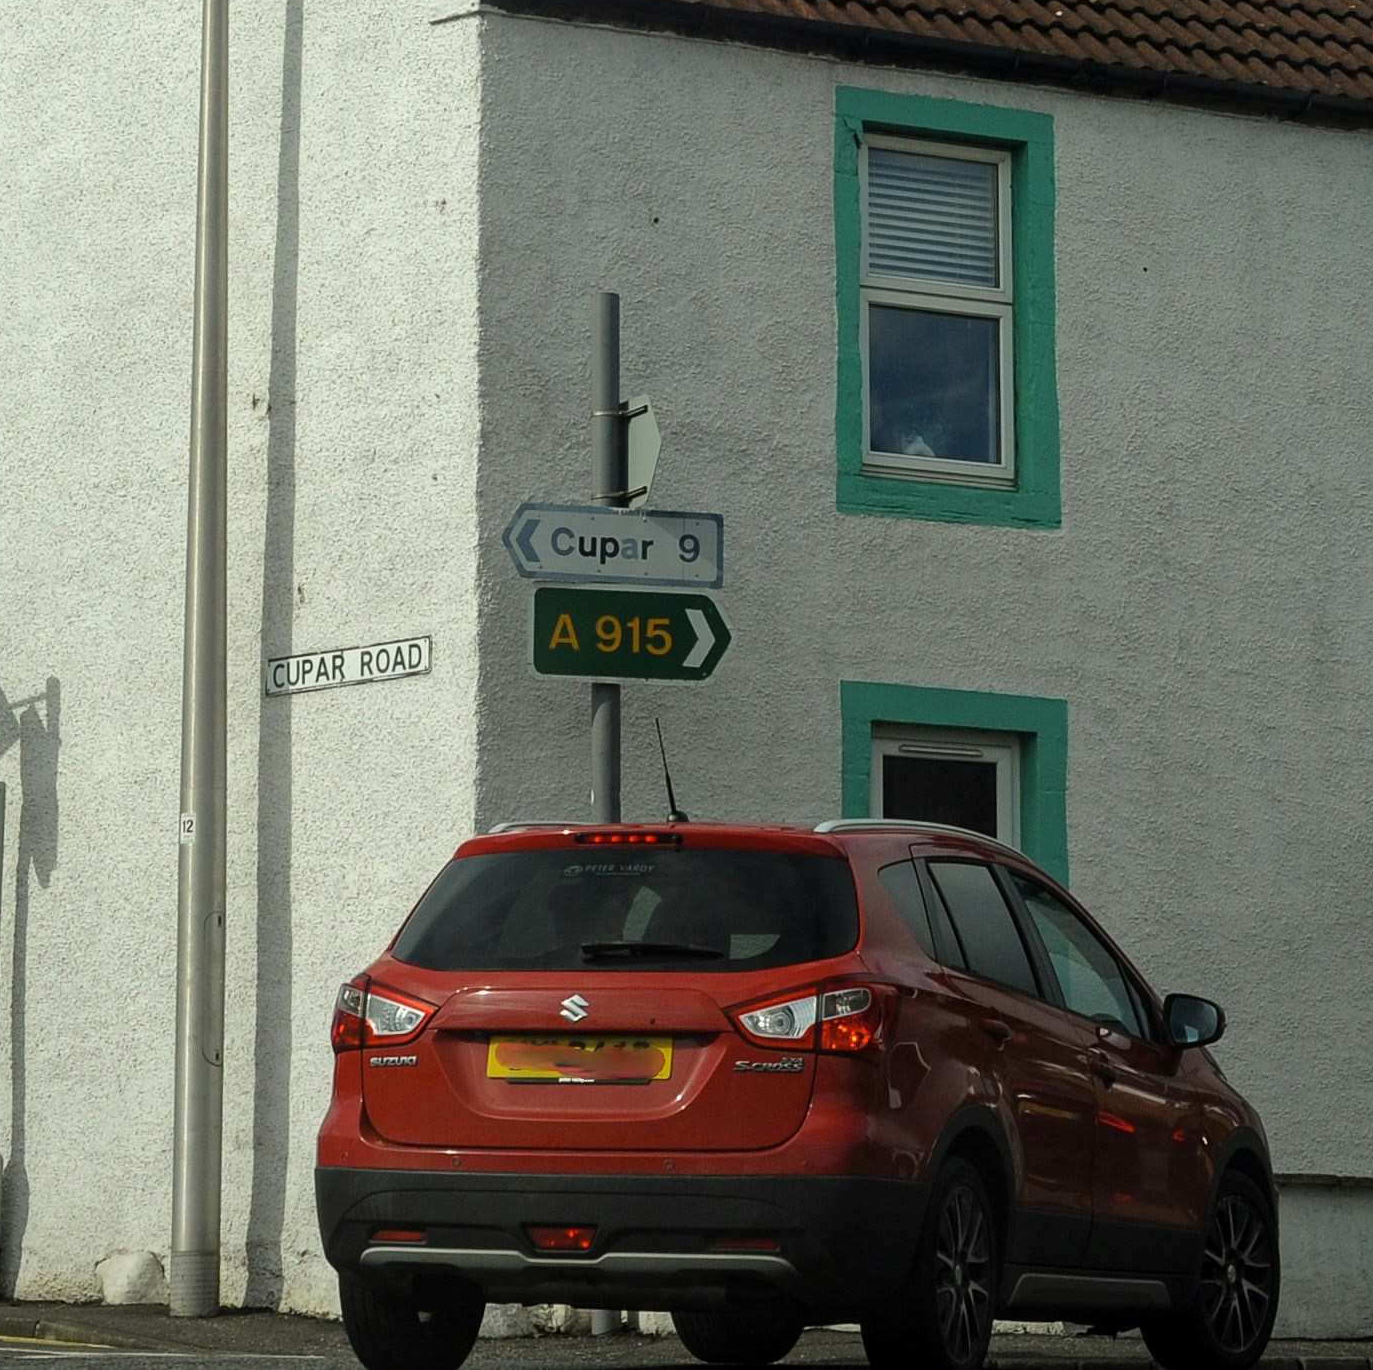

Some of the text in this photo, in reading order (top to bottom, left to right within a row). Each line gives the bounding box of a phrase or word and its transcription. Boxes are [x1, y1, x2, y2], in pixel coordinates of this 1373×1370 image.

[550, 526, 700, 565] Cupar 9
[548, 613, 673, 656] A 915
[273, 643, 422, 688] CUPAR ROAD
[182, 819, 194, 833] 12
[369, 1055, 418, 1067] SUZUKI
